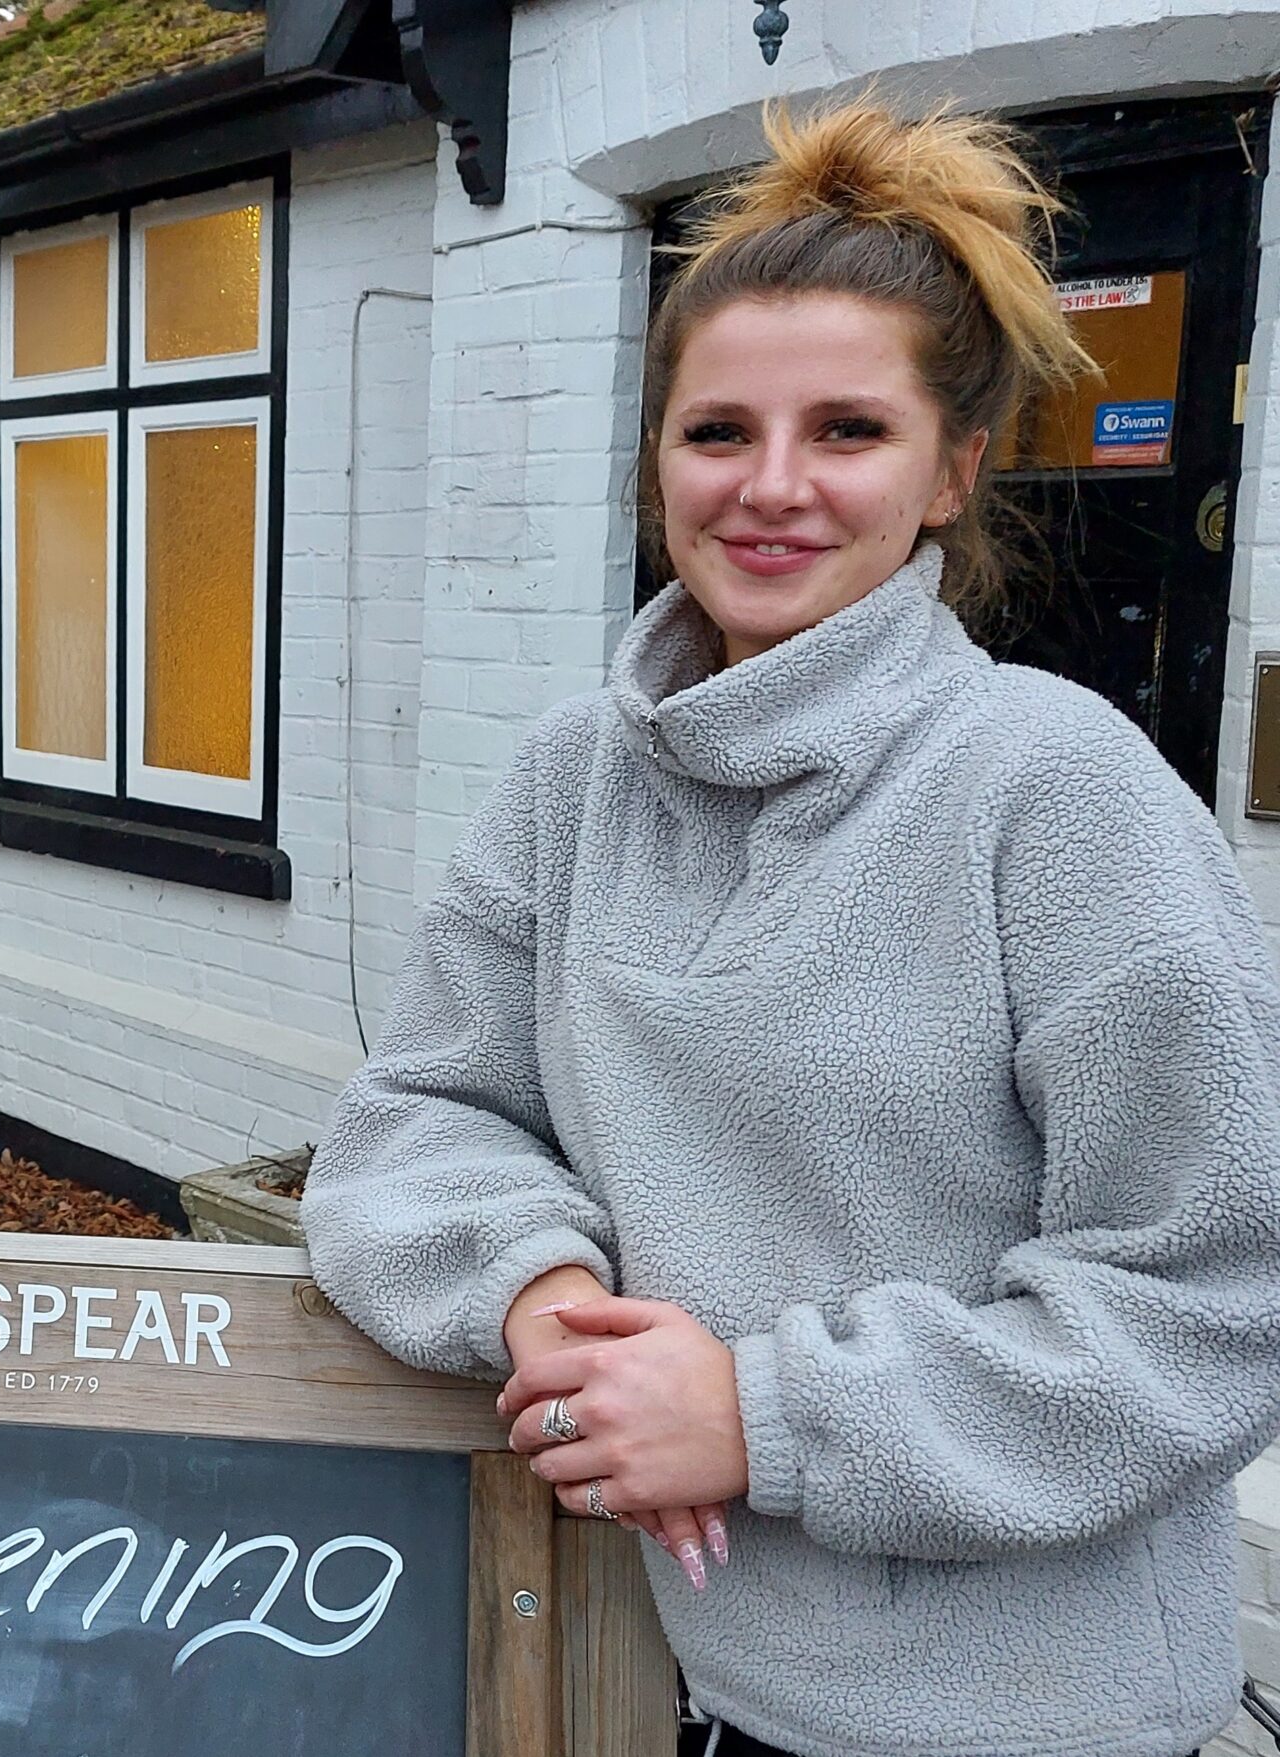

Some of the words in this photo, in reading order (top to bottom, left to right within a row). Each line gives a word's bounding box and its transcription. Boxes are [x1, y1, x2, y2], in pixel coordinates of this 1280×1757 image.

[1058, 282, 1092, 292] ALCOHOL
[1094, 281, 1104, 289] TO
[1106, 277, 1132, 288] UNDER
[1075, 295, 1096, 308] THE
[1098, 292, 1127, 305] LAW!
[1120, 416, 1165, 429] Swann
[48, 1375, 99, 1394] 1779
